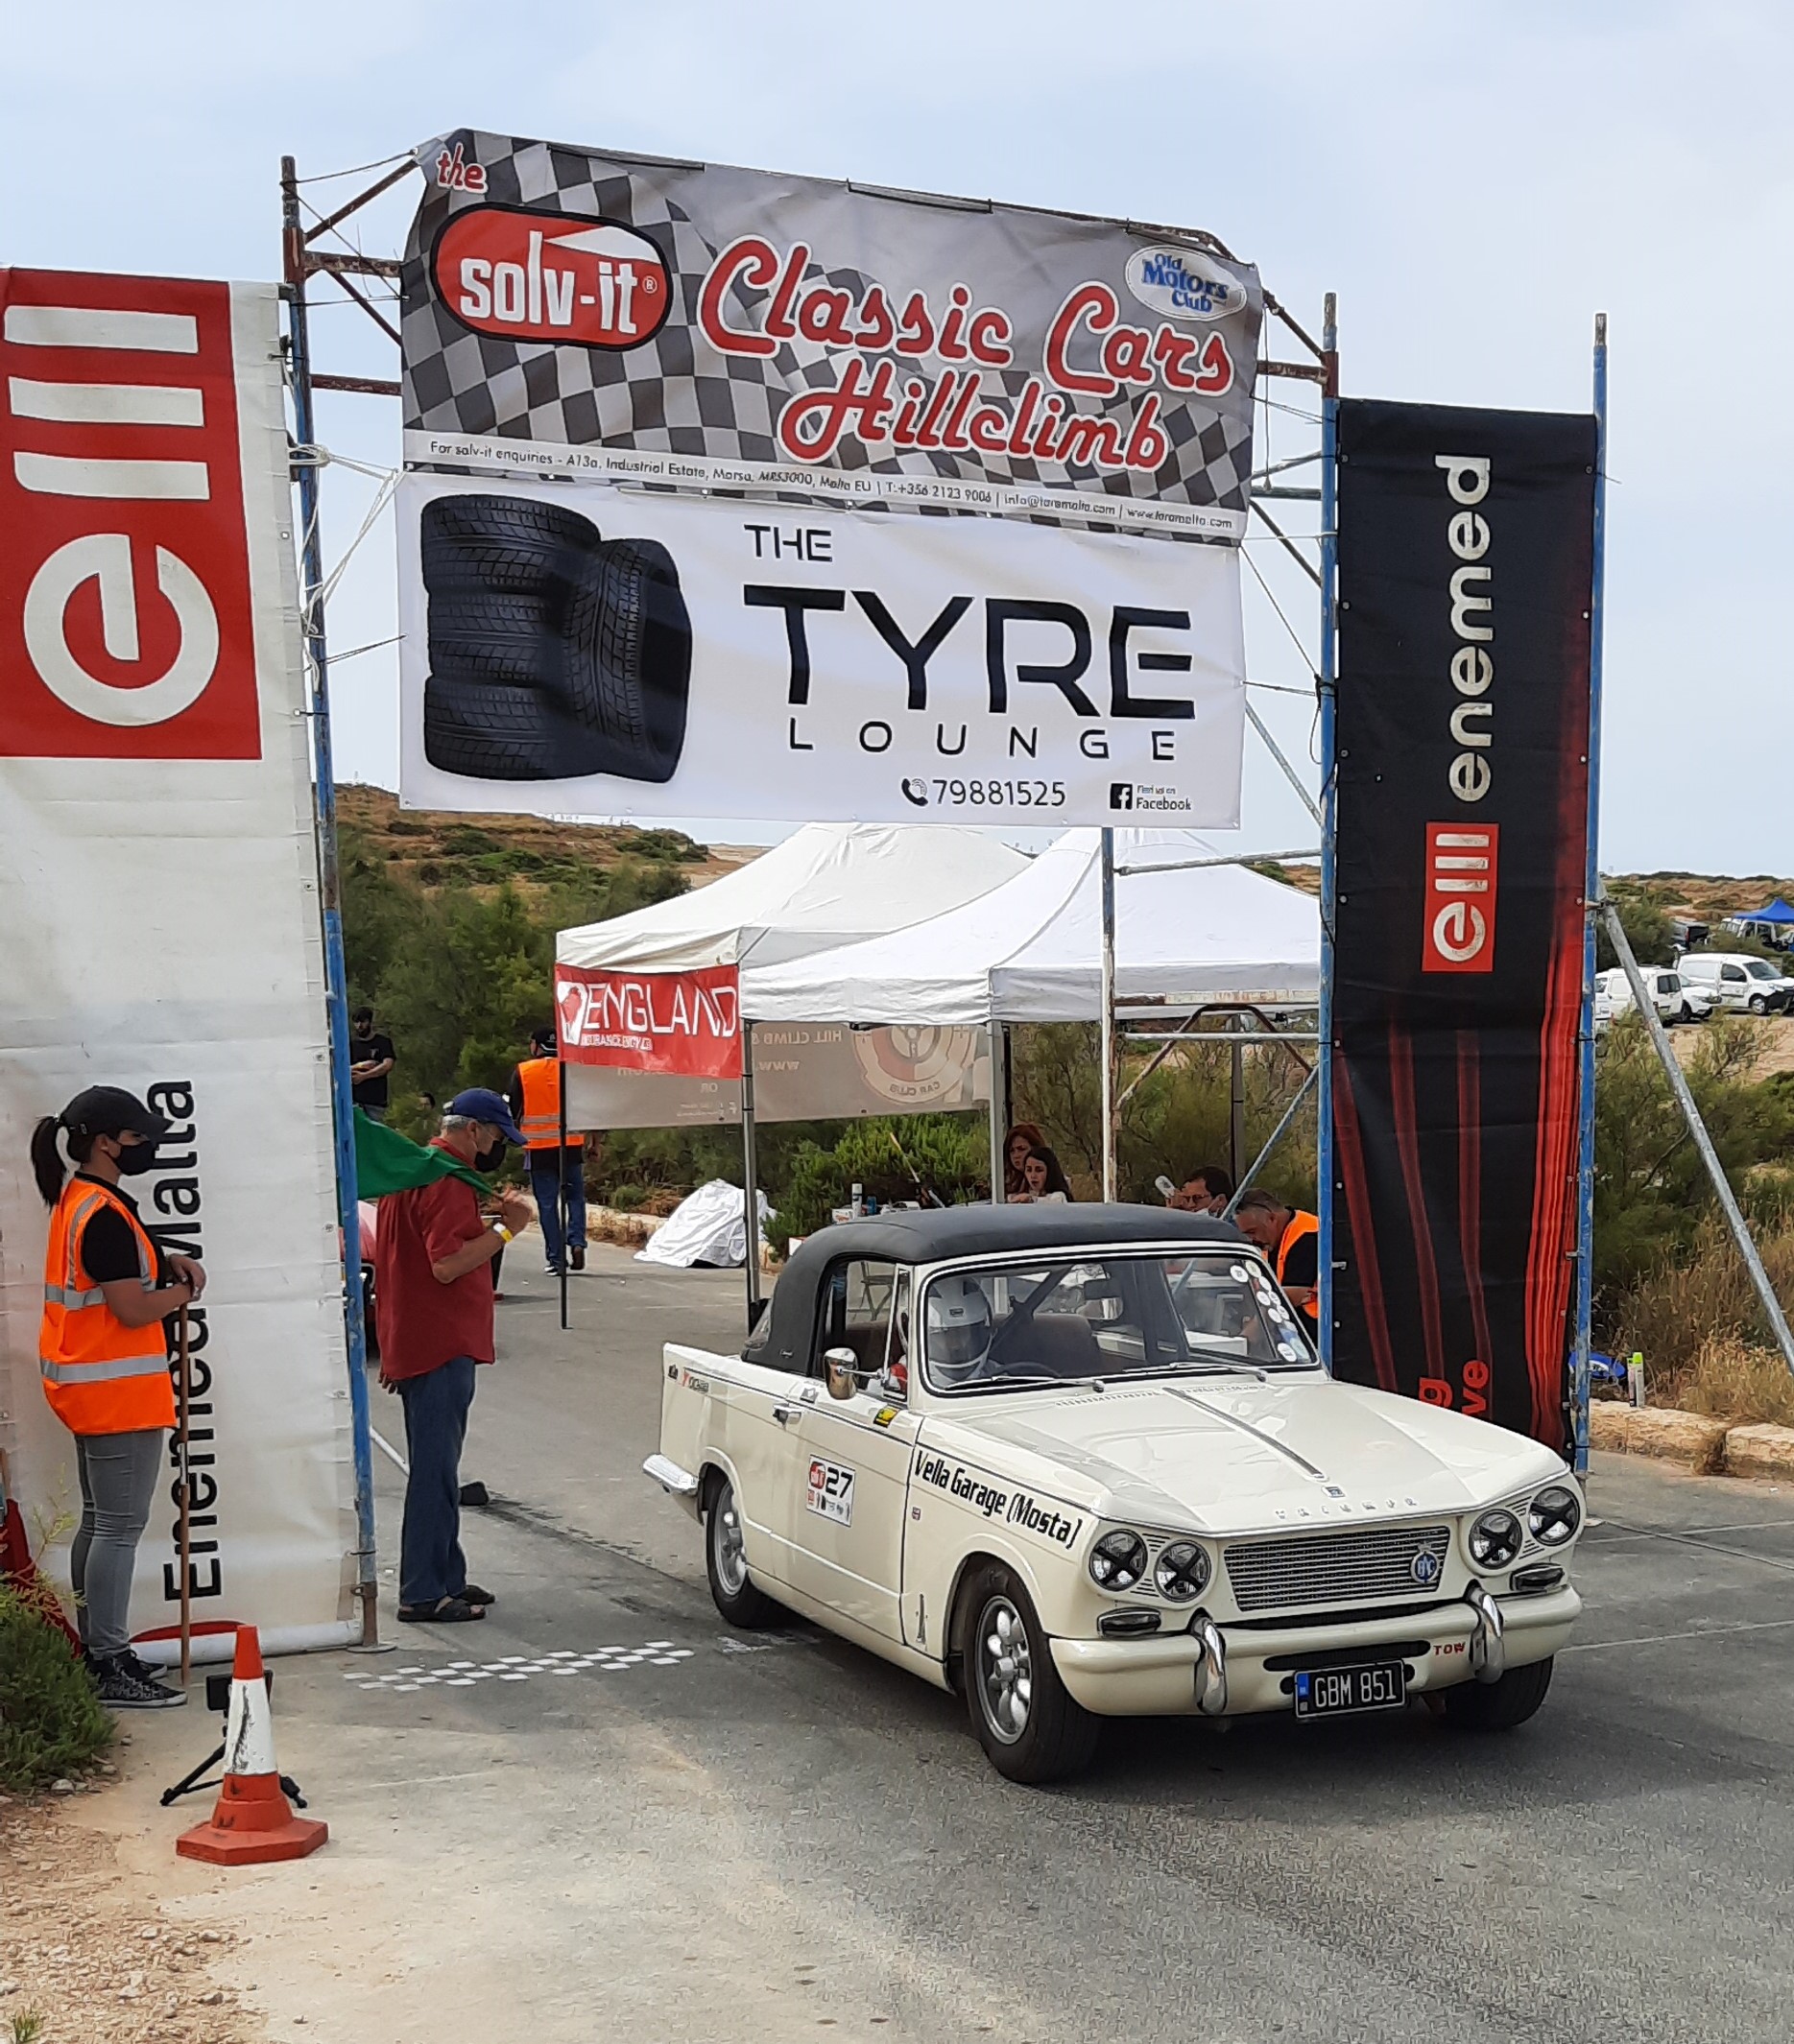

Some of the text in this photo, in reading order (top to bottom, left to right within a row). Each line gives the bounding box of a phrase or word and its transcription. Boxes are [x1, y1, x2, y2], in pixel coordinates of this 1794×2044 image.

[437, 143, 487, 193] the
[460, 230, 638, 335] solv-it
[1142, 259, 1229, 299] Motors
[1155, 253, 1183, 270] Old
[698, 235, 1233, 397] Classic Cars
[1172, 289, 1212, 312] Club
[777, 357, 1168, 470] Hillclimb
[430, 441, 452, 454] For
[496, 450, 553, 465] enquiries
[607, 457, 663, 474] Industrial
[820, 476, 850, 490] Malta
[854, 480, 872, 492] EU
[932, 485, 961, 499] 2123
[966, 489, 992, 503] 9006
[744, 524, 832, 562] THE
[1435, 455, 1494, 802] enemed
[744, 584, 1195, 720] TYRE
[790, 717, 1175, 761] LOUNGE
[932, 779, 1065, 806] 79881525
[1136, 796, 1192, 810] Facebook
[584, 983, 737, 1037] ENGLAND
[825, 1466, 853, 1498] 27
[915, 1450, 1083, 1550] Vella Garage (Mosta)
[1433, 1641, 1466, 1656] TOW
[1315, 1669, 1397, 1707] GBM 851
